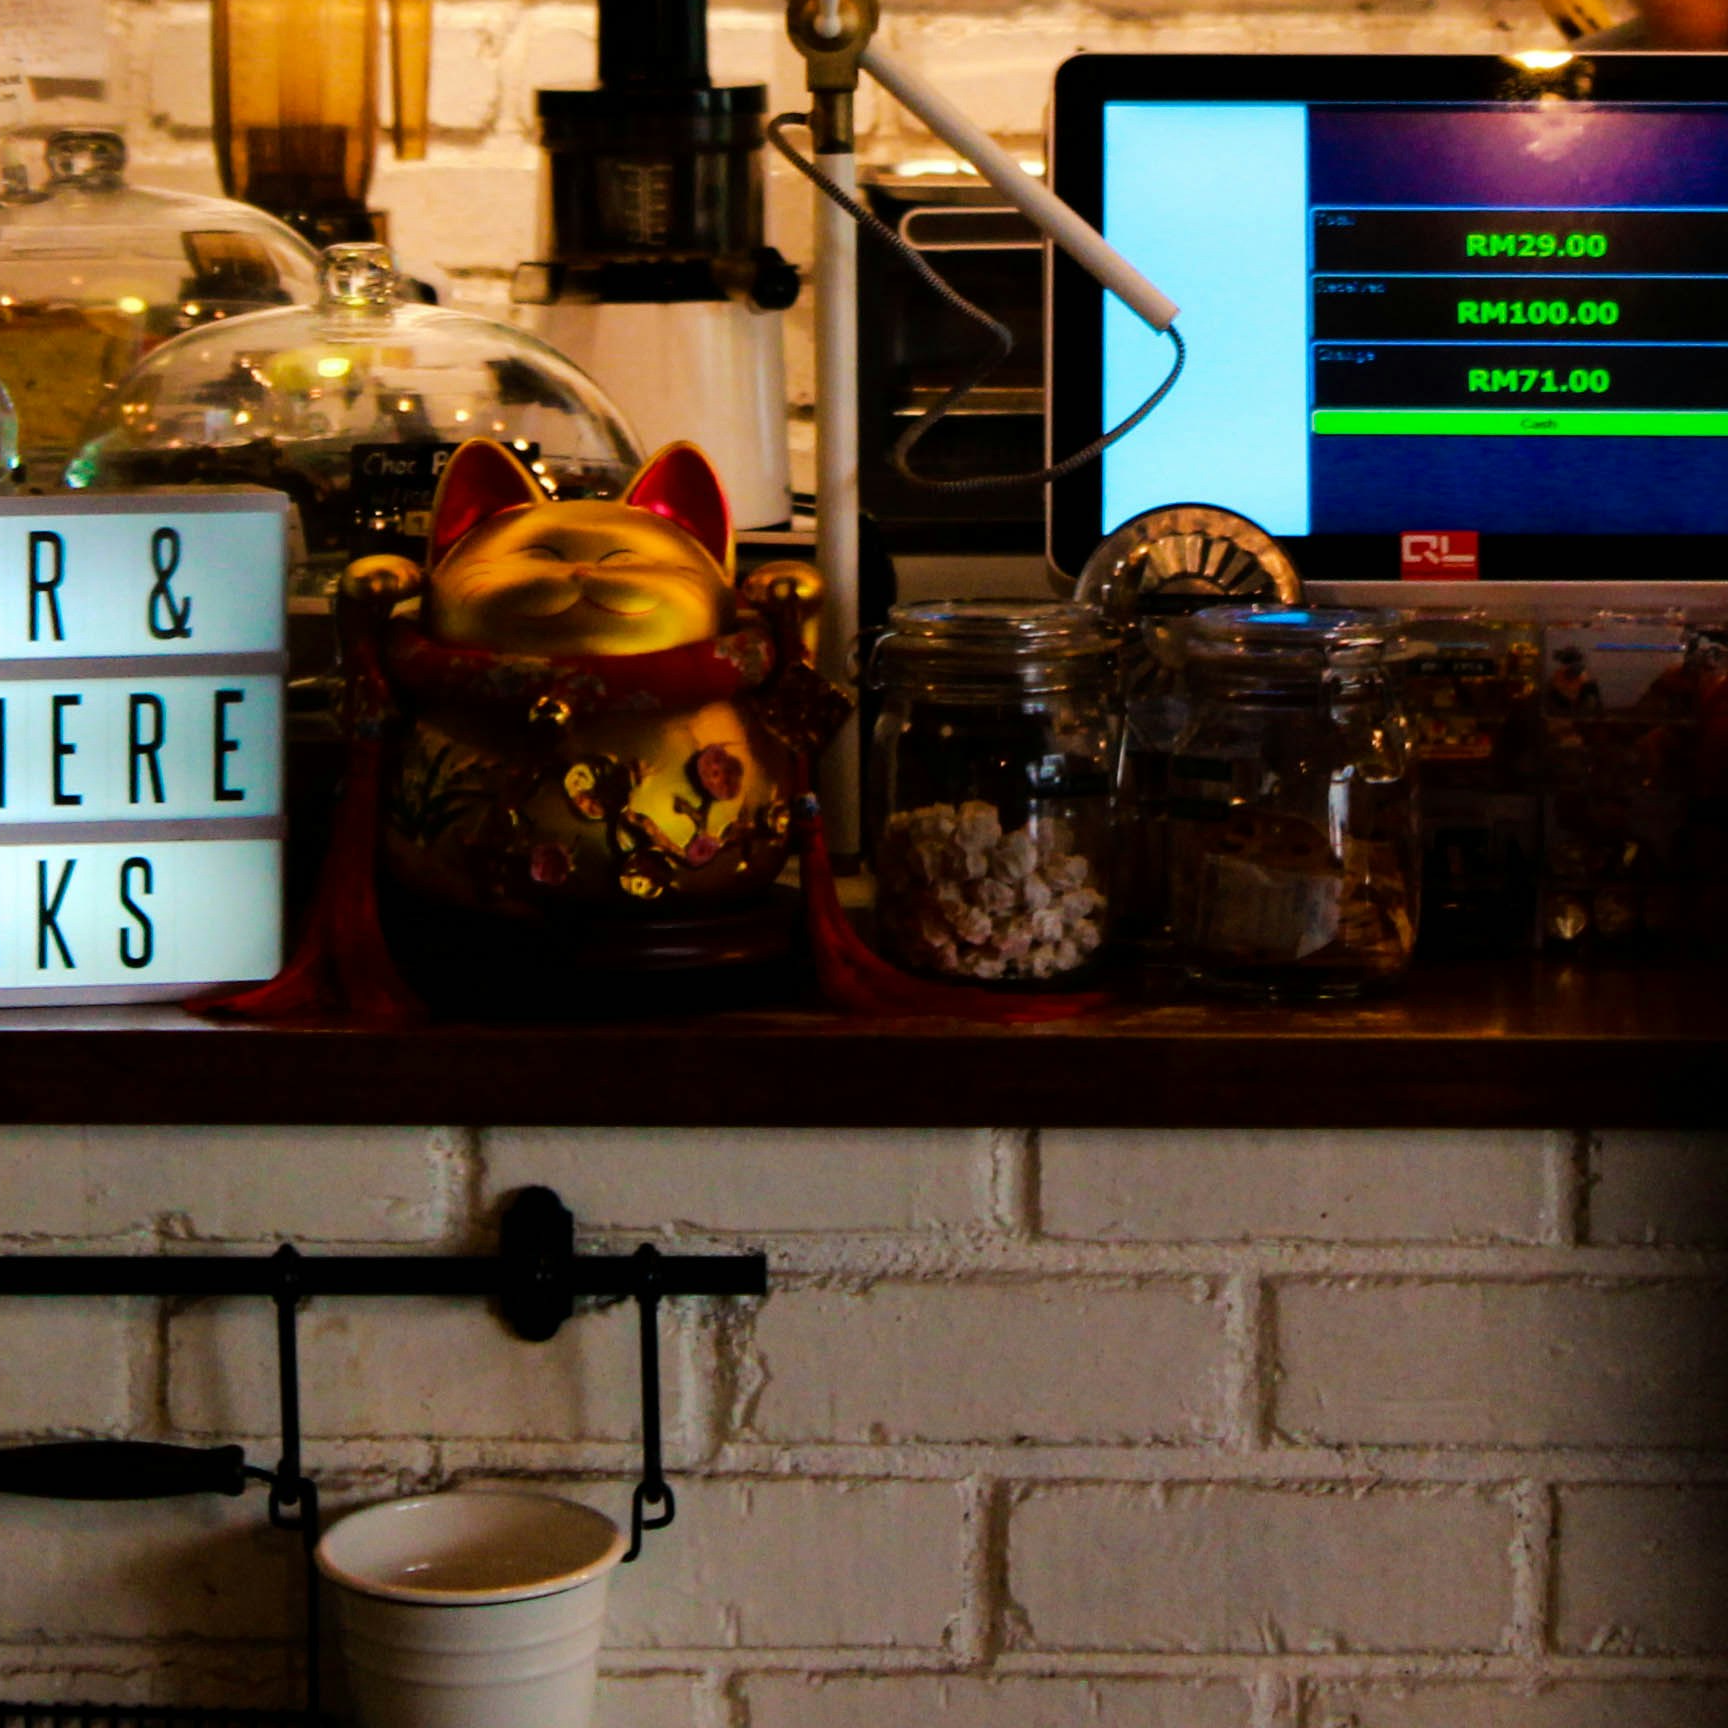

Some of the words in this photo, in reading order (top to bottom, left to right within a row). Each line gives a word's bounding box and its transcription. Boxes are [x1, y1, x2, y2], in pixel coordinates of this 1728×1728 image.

[1465, 232, 1609, 260] RM29.00
[1457, 299, 1620, 327] RM100.00
[1467, 367, 1611, 395] RM71.00
[147, 527, 193, 640] &
